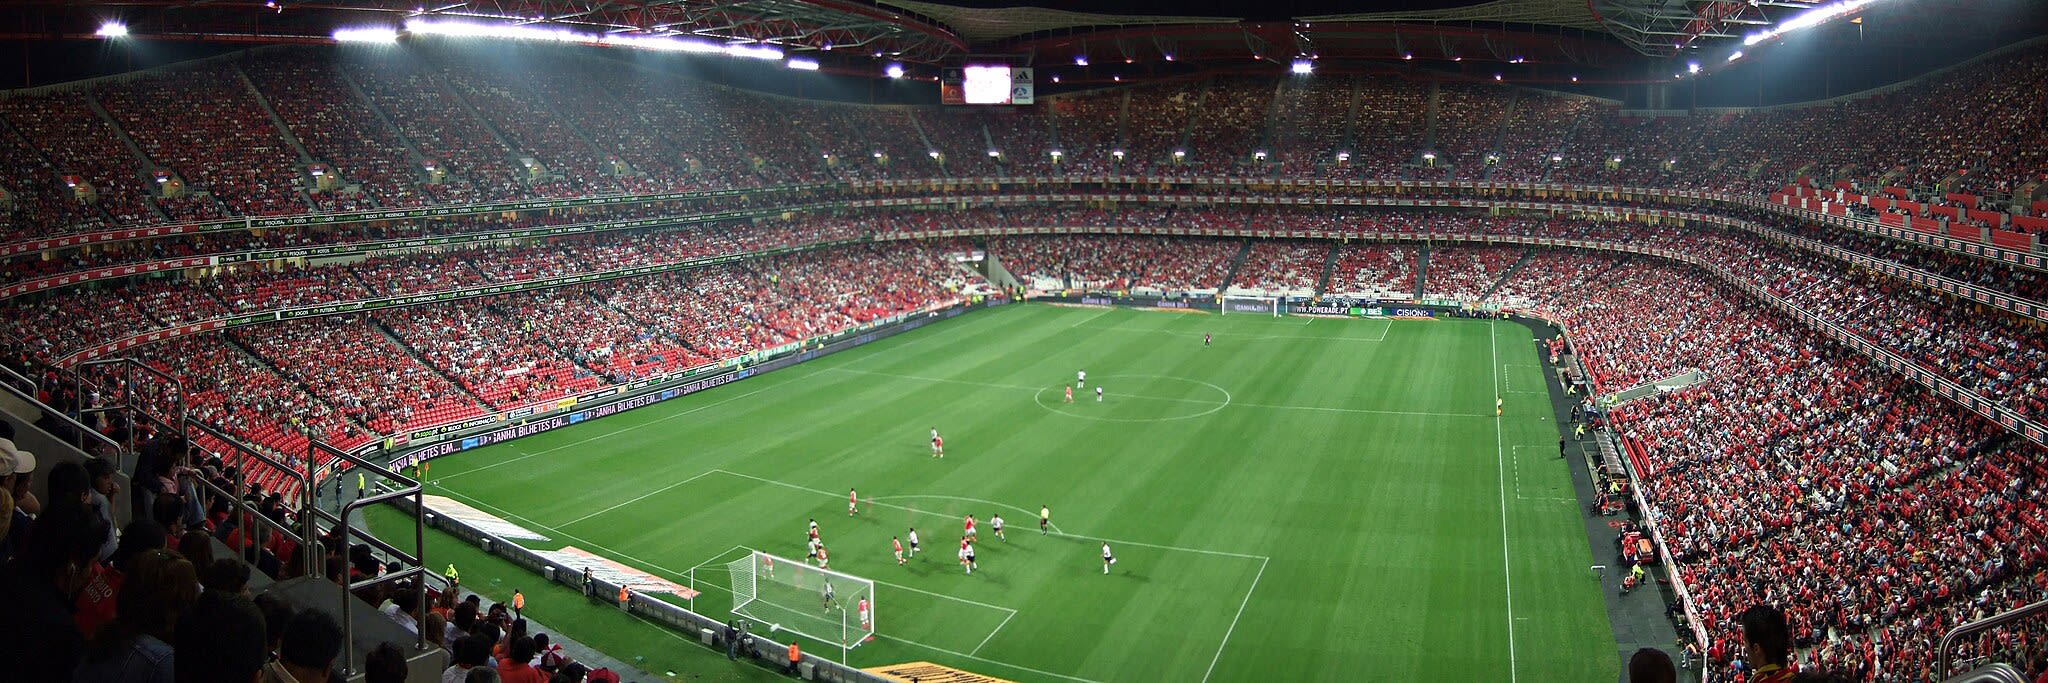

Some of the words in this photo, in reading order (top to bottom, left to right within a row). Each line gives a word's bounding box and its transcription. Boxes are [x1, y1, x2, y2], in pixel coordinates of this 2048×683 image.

[1396, 308, 1424, 317] CISION
[518, 420, 550, 437] BILHETES
[617, 397, 645, 412] BILHETES
[701, 375, 724, 390] BILHETES
[468, 416, 496, 428] INFORMAÇÃO
